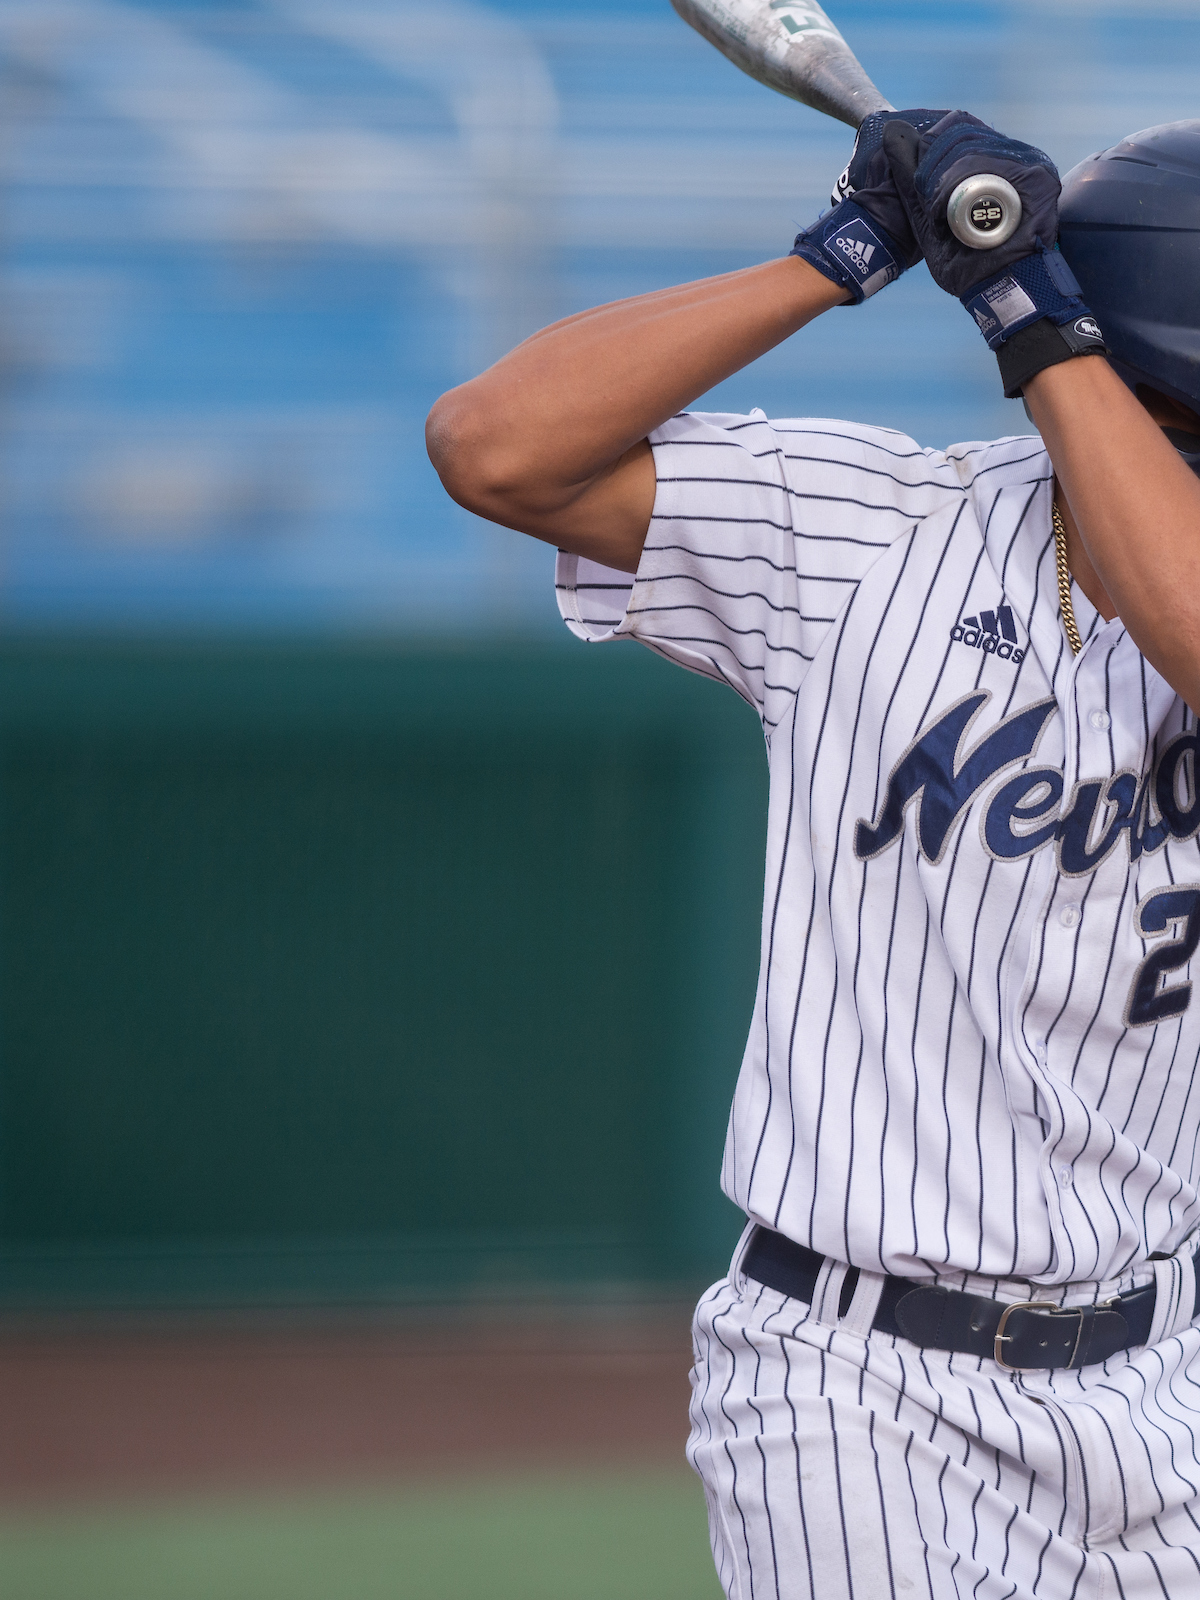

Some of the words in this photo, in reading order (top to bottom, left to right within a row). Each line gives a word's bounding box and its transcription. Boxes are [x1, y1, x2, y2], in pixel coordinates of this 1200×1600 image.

[973, 207, 1001, 221] 33
[836, 237, 869, 275] adidas
[950, 624, 1024, 664] adidas
